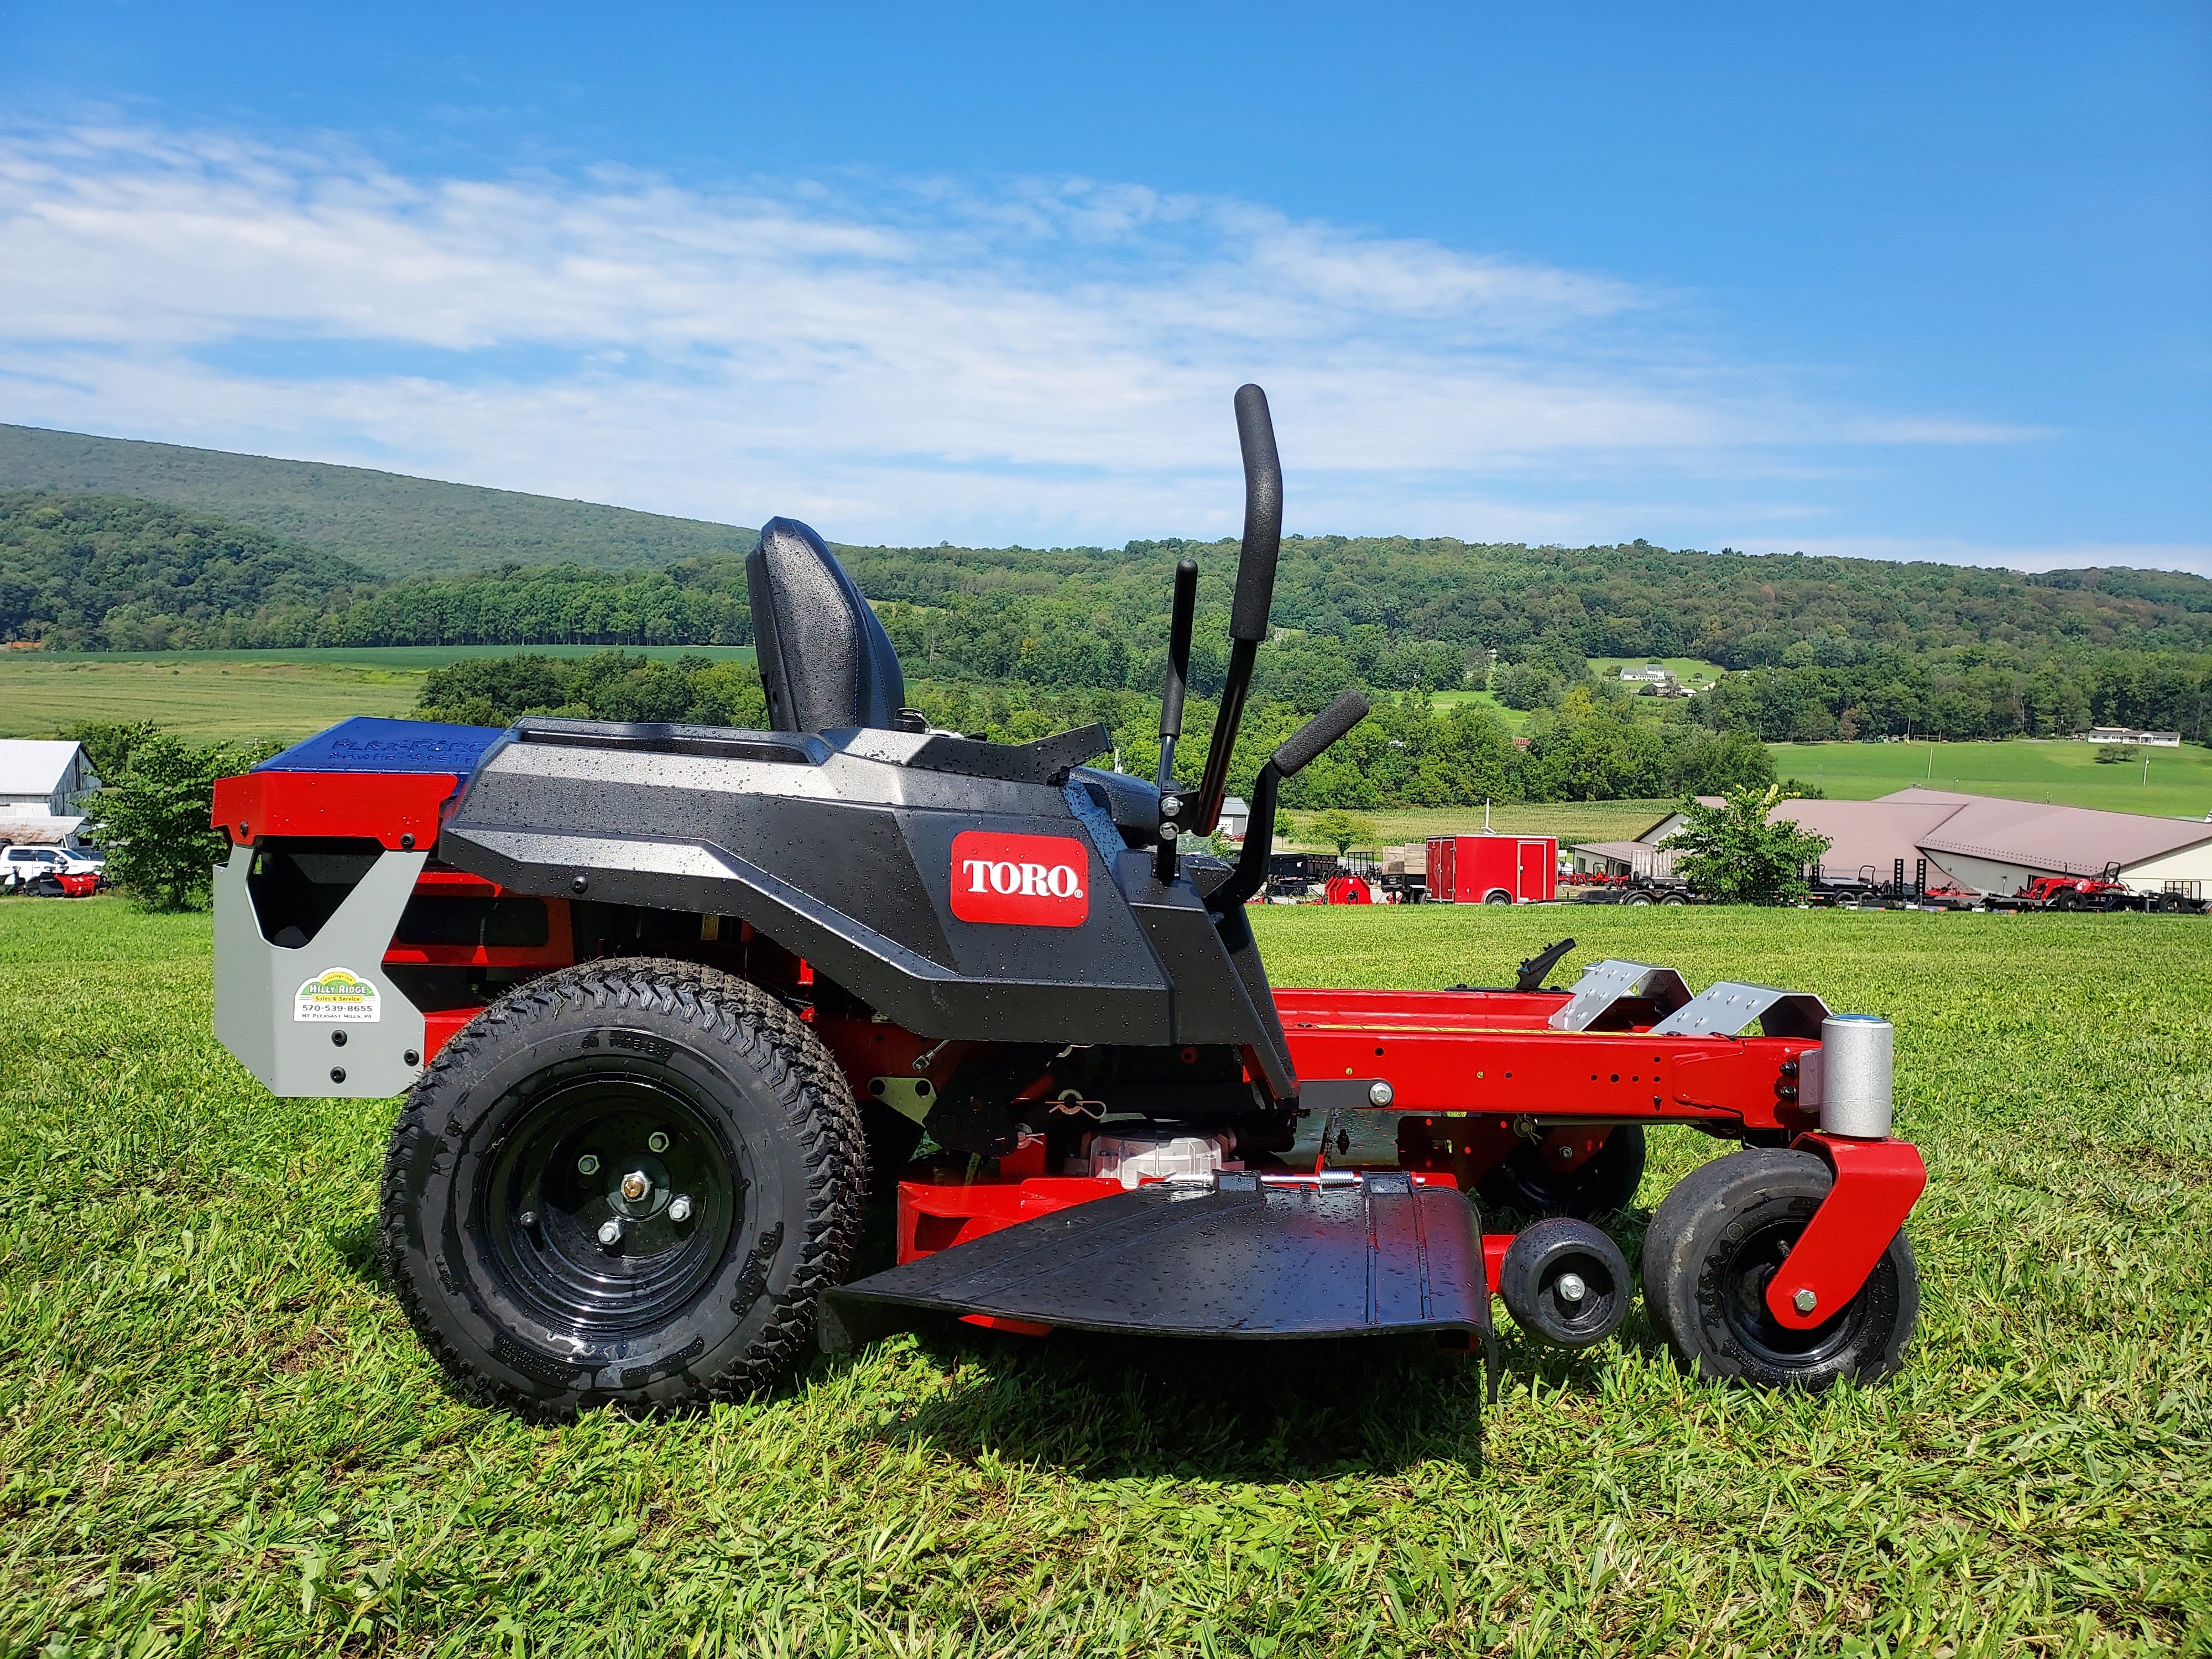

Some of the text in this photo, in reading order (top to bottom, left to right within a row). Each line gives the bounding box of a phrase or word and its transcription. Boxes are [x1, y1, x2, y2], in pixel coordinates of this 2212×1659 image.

[331, 739, 487, 753] FLEX-FORC
[409, 754, 475, 763] SYSTE
[963, 860, 1078, 898] TORO
[310, 984, 367, 994] HILLY RIDGE
